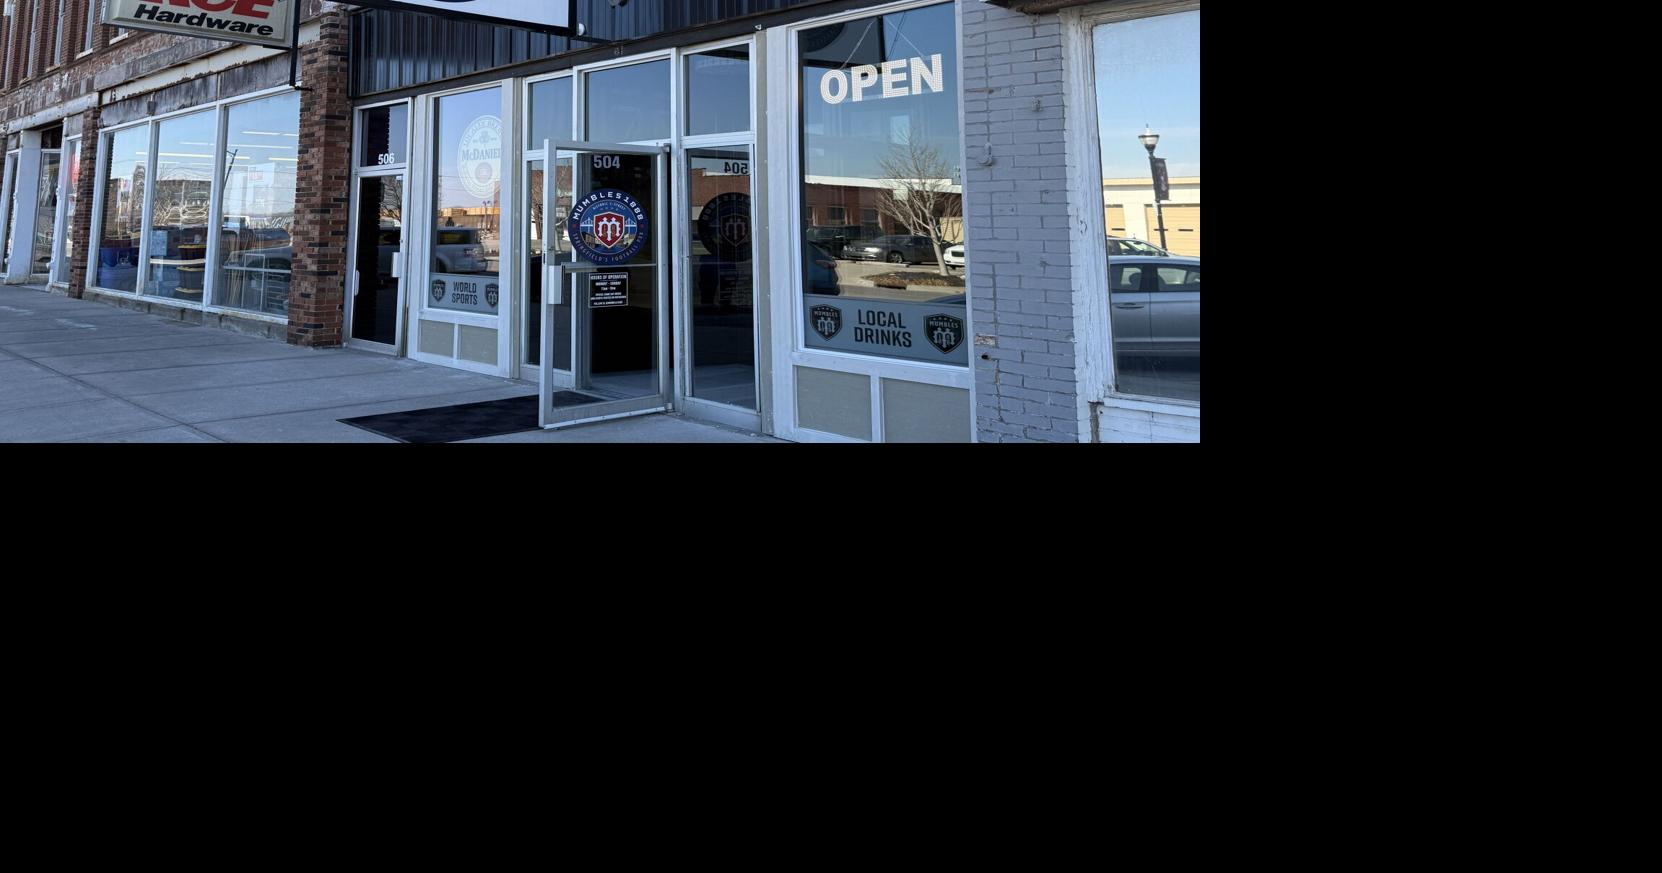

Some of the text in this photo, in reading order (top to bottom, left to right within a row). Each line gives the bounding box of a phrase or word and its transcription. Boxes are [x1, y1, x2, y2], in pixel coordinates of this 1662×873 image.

[134, 3, 274, 36] Hardware
[821, 53, 943, 104] OPEN
[378, 153, 394, 165] 506
[593, 155, 620, 168] 504
[453, 281, 476, 293] WORLD
[452, 293, 478, 305] SPORTS
[858, 309, 906, 329] LOCAL
[854, 326, 912, 348] DRINKS
